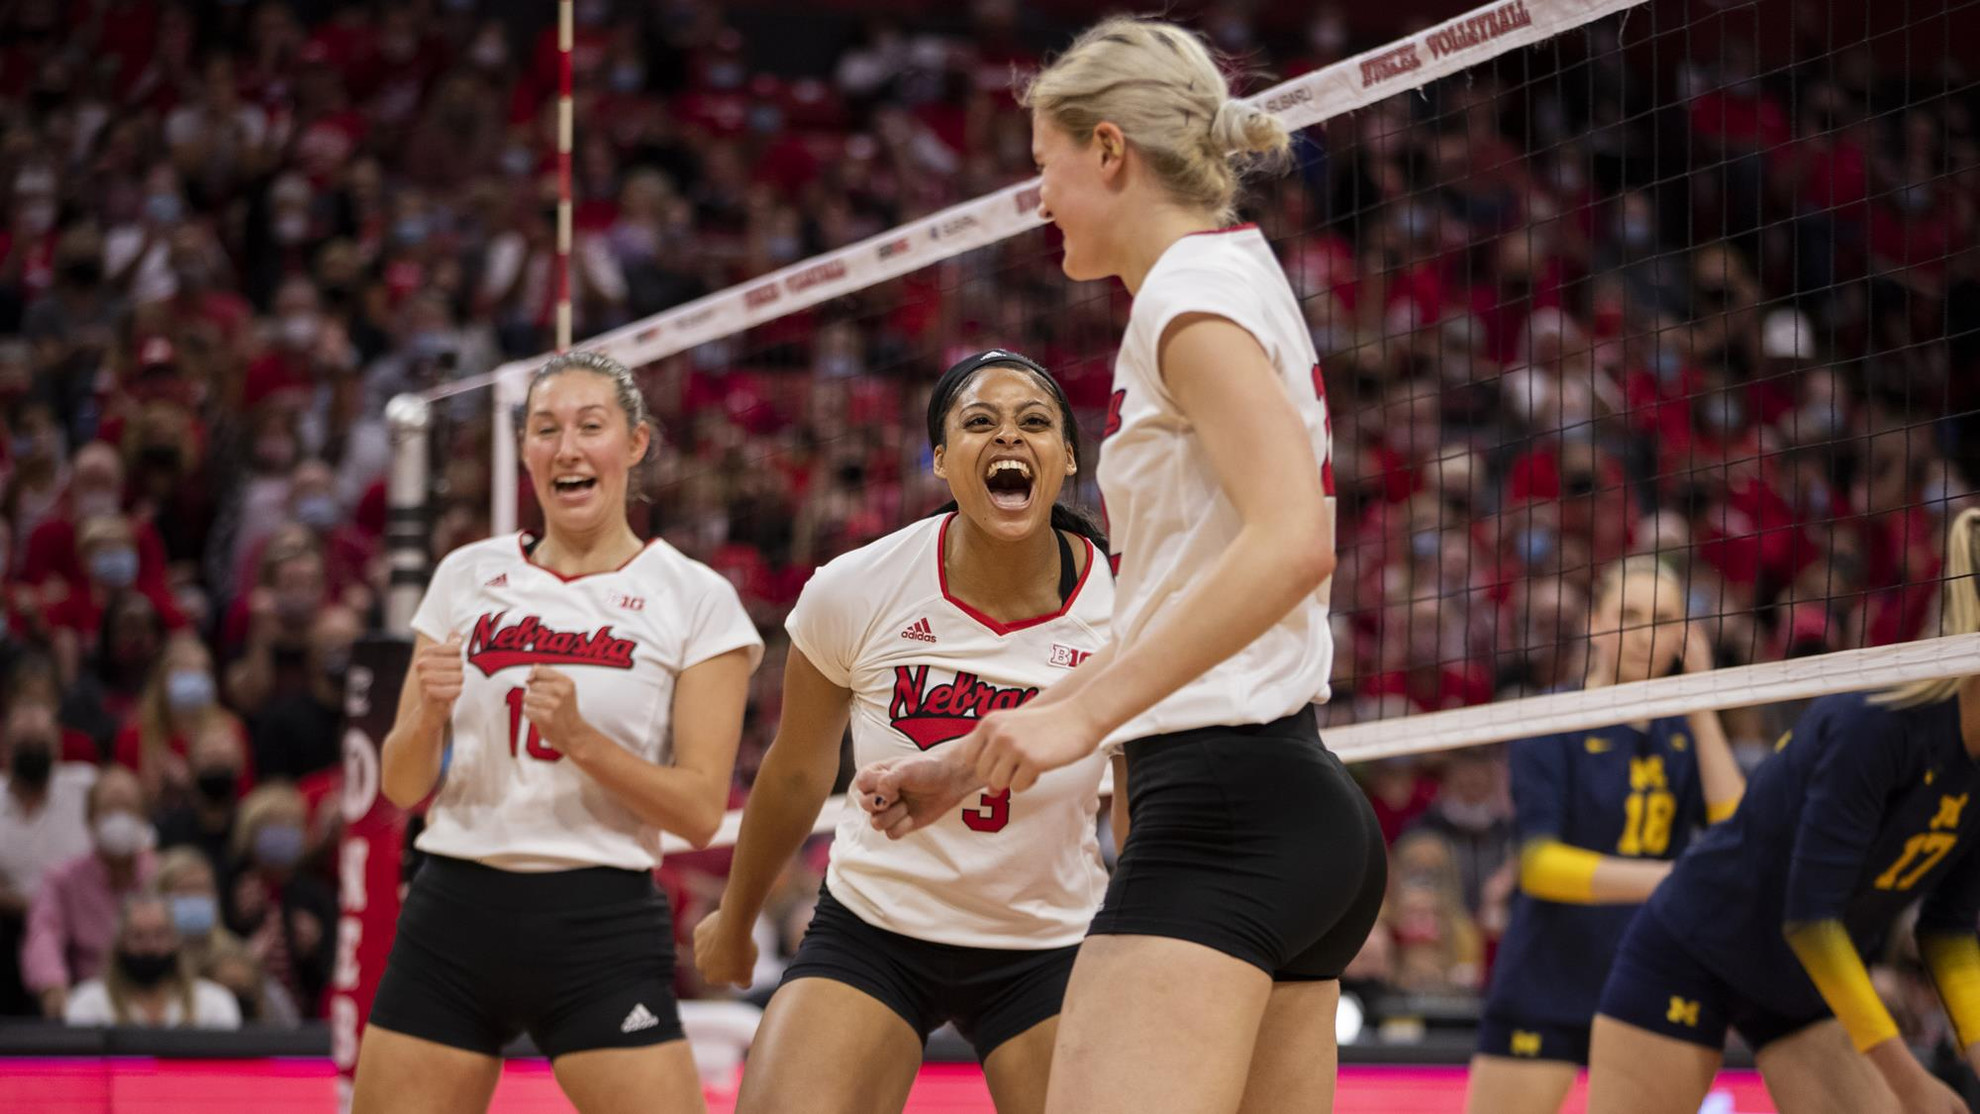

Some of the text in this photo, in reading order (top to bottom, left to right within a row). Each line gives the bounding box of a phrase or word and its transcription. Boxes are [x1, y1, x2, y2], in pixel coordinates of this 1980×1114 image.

[1426, 1, 1531, 60] VOLLEYBALL
[467, 610, 637, 671] Nebraska
[901, 628, 937, 643] adidas
[962, 787, 1010, 833] 3
[1618, 792, 1676, 855] 18
[1874, 832, 1958, 890] 17
